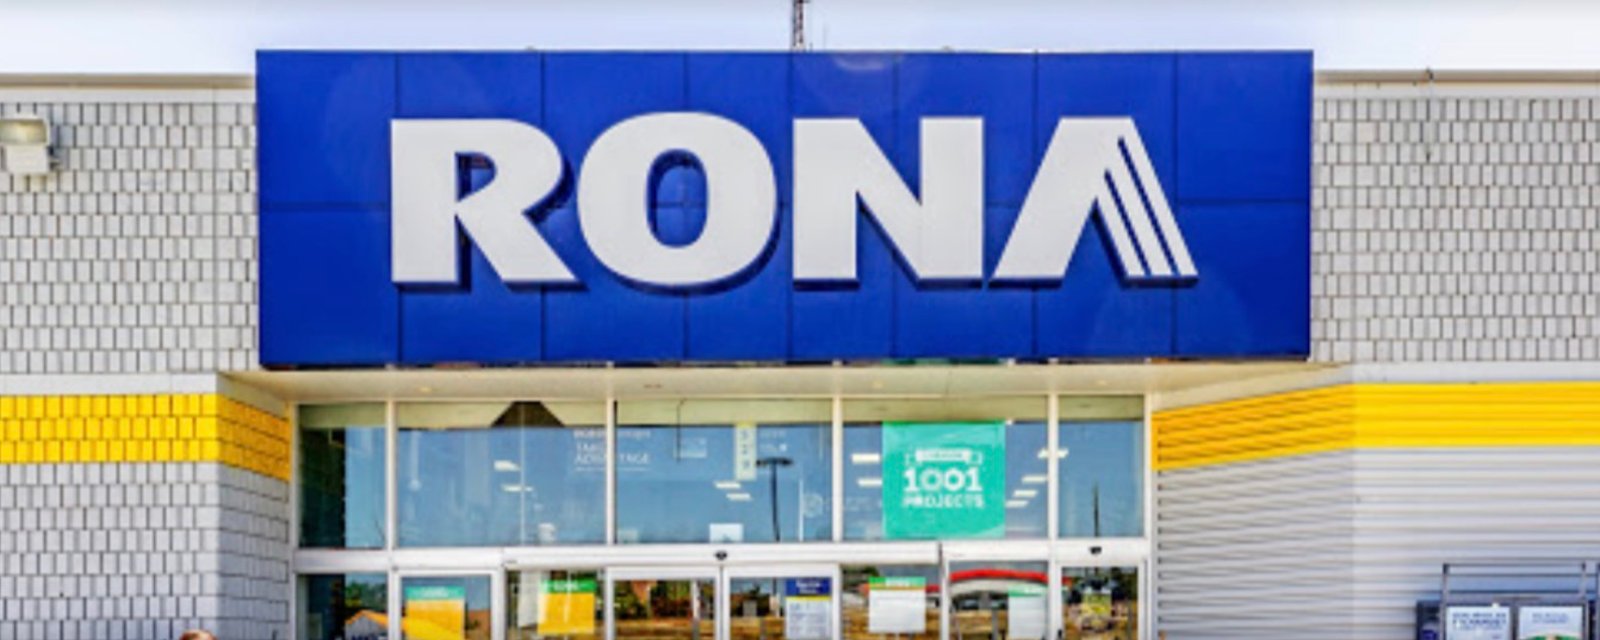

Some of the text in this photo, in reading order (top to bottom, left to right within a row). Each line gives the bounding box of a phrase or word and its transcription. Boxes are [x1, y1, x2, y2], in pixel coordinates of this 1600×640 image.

[391, 112, 1198, 286] RONA
[903, 467, 983, 491] 1001
[902, 494, 984, 508] PROJECTS
